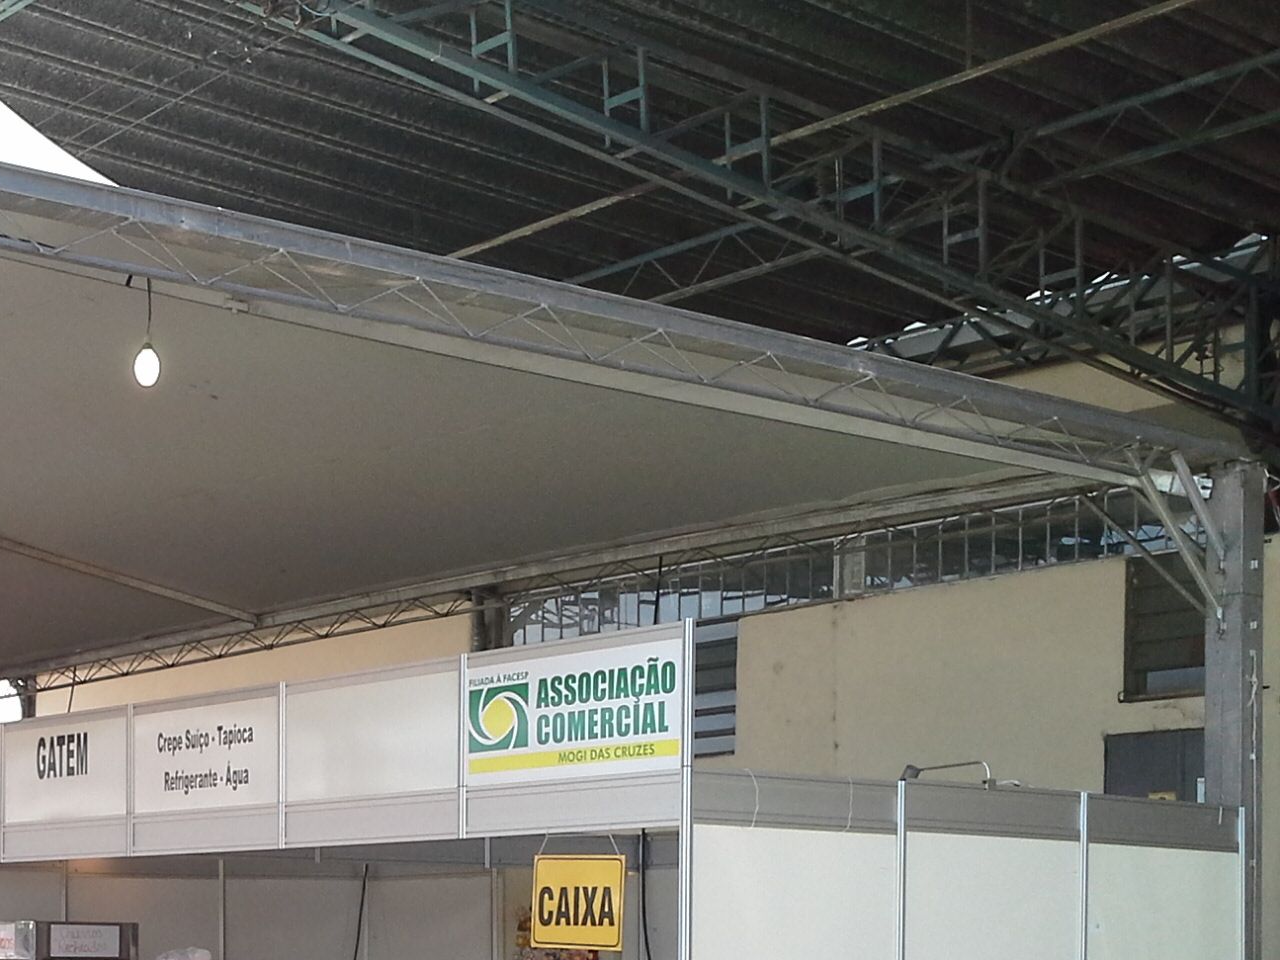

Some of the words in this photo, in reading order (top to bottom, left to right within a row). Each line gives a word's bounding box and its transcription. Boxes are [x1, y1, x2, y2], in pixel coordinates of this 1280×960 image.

[536, 657, 677, 709] ASSOCIAÇÃO
[157, 732, 183, 756] Crepe
[217, 724, 254, 751] Tapioca
[536, 701, 669, 746] COMERCIAL
[36, 732, 88, 779] GATEM
[558, 750, 587, 763] MOGI
[590, 748, 611, 761] DAS
[613, 744, 656, 758] CRUZES
[164, 768, 218, 795] Refrigerante
[225, 761, 249, 791] Água
[538, 886, 615, 926] CAIXA
